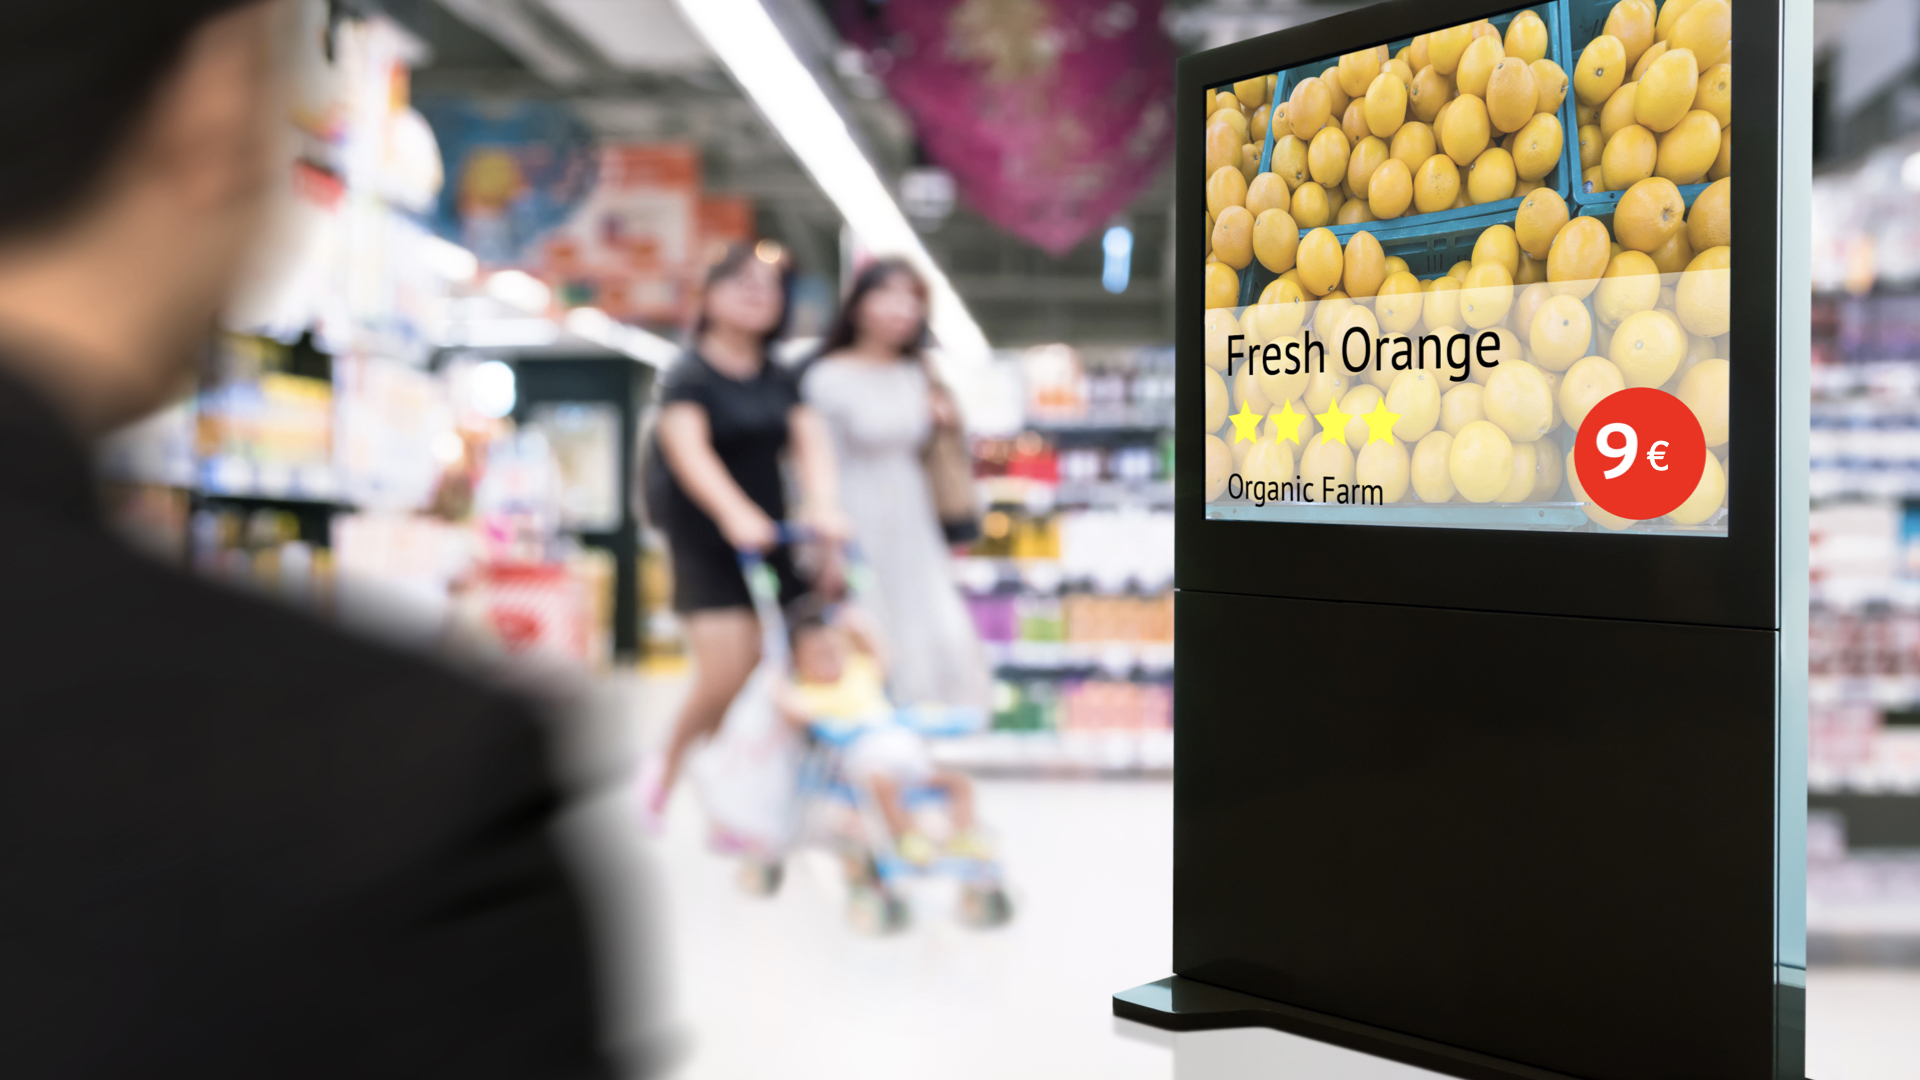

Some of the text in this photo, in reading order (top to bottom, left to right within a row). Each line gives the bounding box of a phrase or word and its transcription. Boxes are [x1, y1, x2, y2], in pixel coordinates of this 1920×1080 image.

[1227, 326, 1501, 382] Fresh Orange
[1227, 473, 1384, 507] Organic Farm
